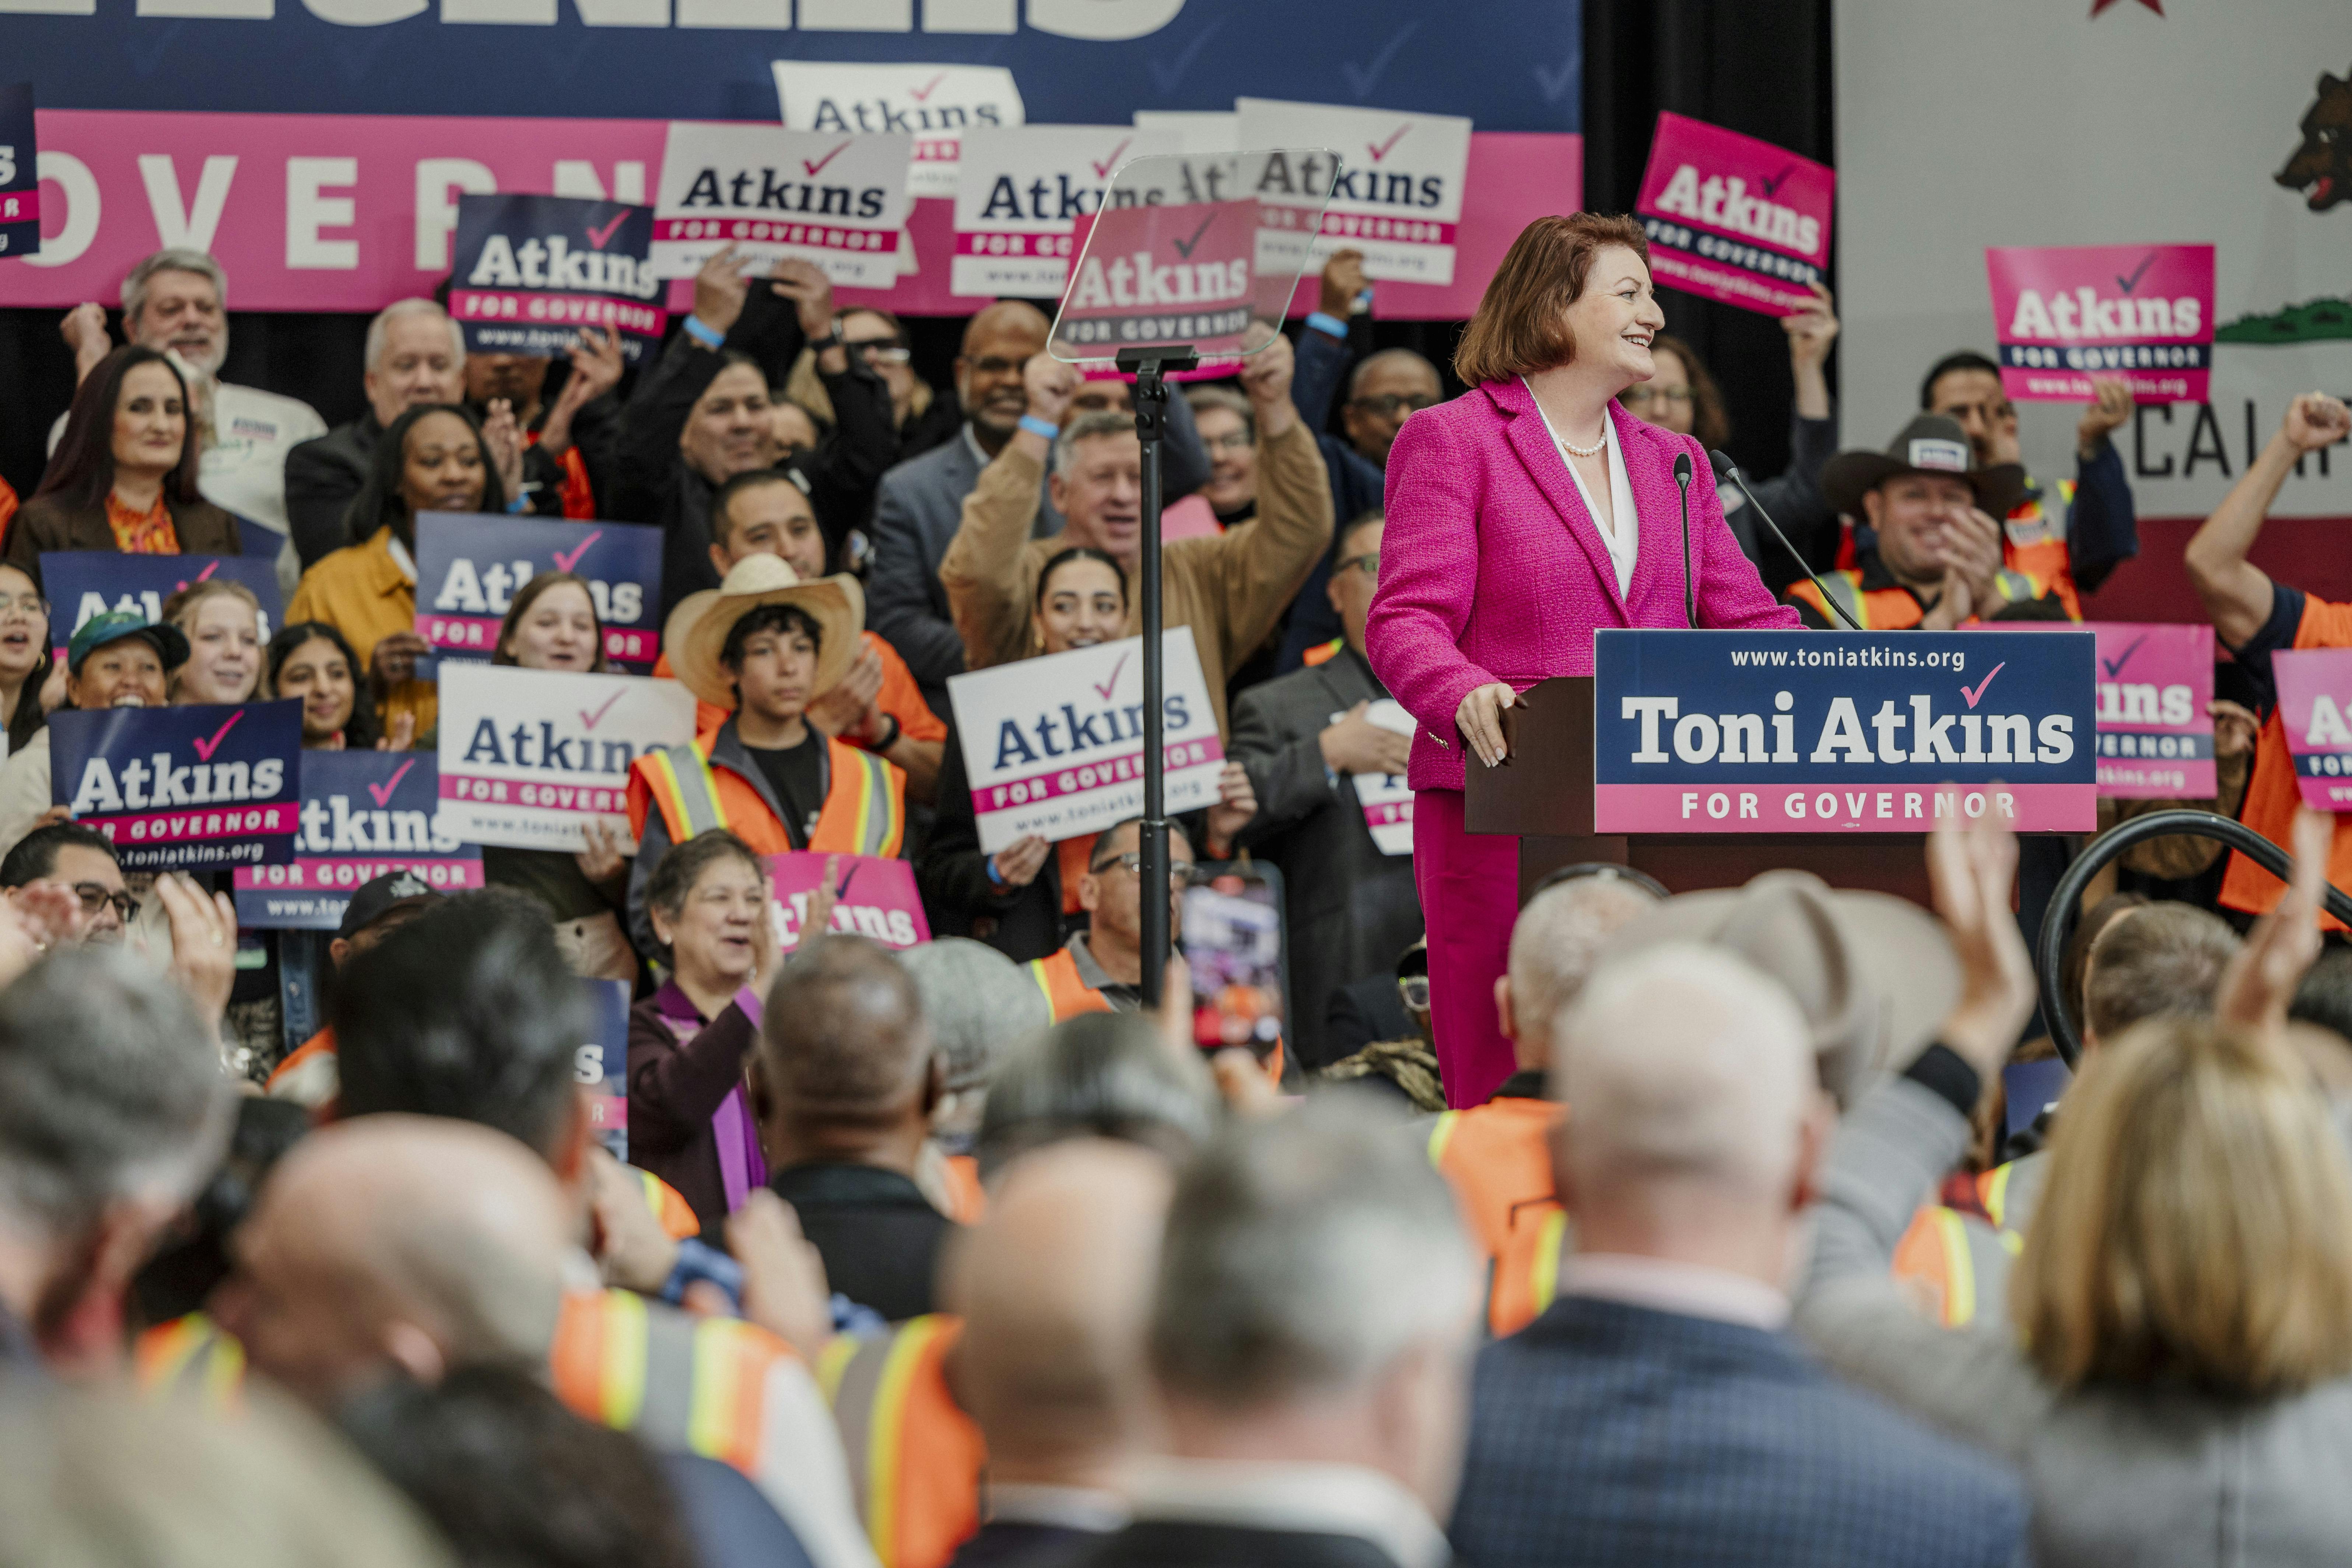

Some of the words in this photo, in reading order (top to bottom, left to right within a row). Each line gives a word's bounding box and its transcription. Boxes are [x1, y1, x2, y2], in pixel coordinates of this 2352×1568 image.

[681, 166, 886, 219] Atkins
[1256, 151, 1443, 208] Atkins
[1655, 164, 1820, 256] Atkins
[669, 220, 721, 239] FOR
[732, 221, 884, 250] GOVERNOR
[1072, 252, 1249, 309] Atkins
[465, 295, 518, 318] FOR
[2009, 287, 2202, 338] Atkins
[2011, 345, 2060, 368] FOR
[431, 620, 484, 645] FOR
[1731, 647, 1964, 672] www.toniatkins.org
[1622, 691, 1798, 764] Toni
[1810, 695, 2074, 764] Atkins
[73, 753, 284, 813] Atkins
[456, 778, 508, 801] FOR
[992, 777, 1048, 809] FOR
[1682, 793, 1759, 818] FOR
[1784, 792, 2014, 818] GOVERNOR
[130, 809, 280, 841] GOVERNOR
[115, 843, 264, 869] .toniatkins.org
[252, 864, 304, 885] FOR
